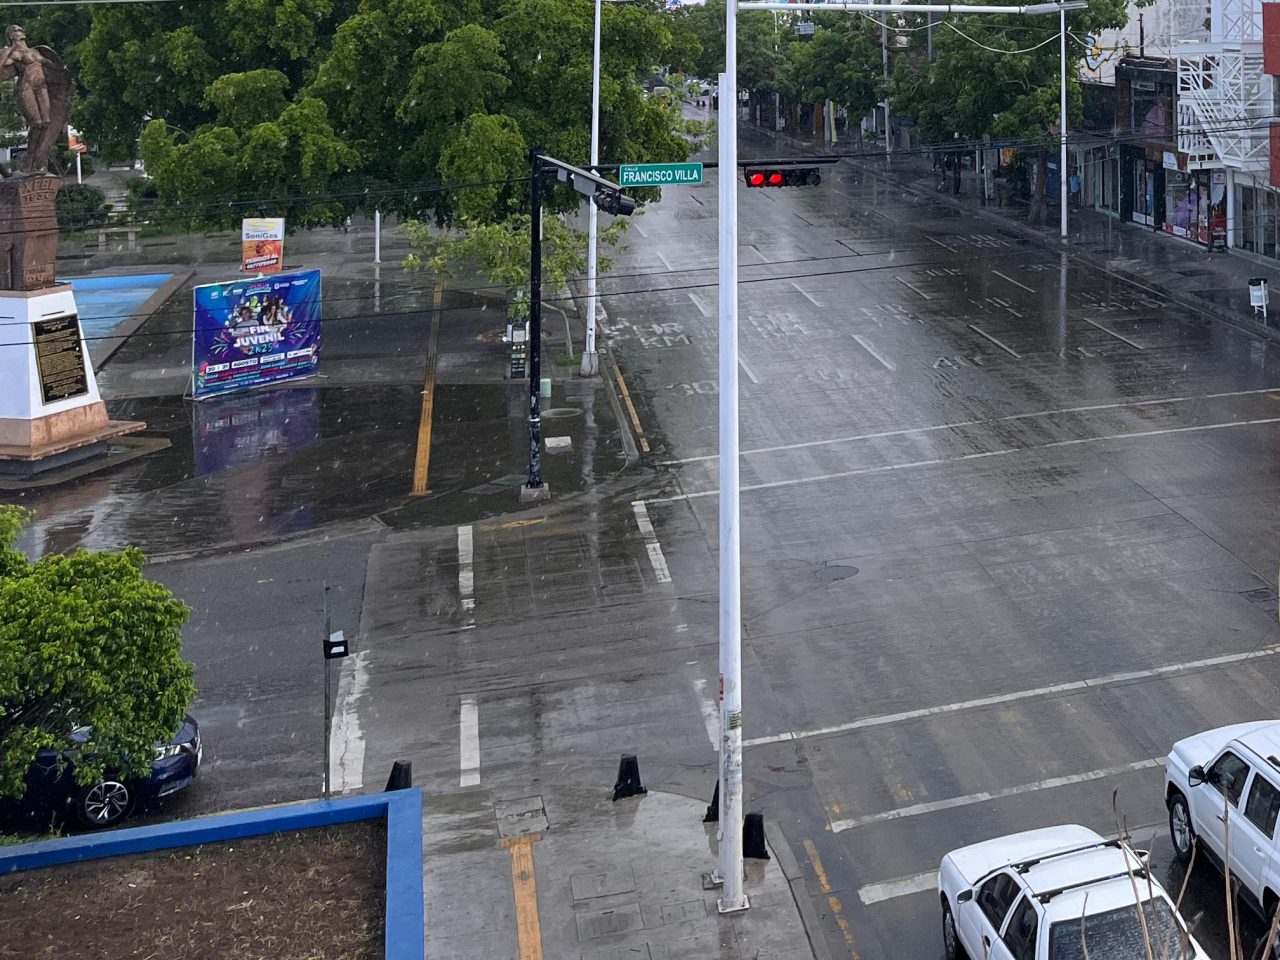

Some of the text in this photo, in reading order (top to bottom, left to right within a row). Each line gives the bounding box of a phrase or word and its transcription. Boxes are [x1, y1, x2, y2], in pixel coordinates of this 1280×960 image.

[623, 169, 699, 182] FRANCISCO VILLA
[250, 325, 269, 335] FIN
[233, 333, 285, 347] JUVENIL
[233, 359, 257, 367] AGOSTO
